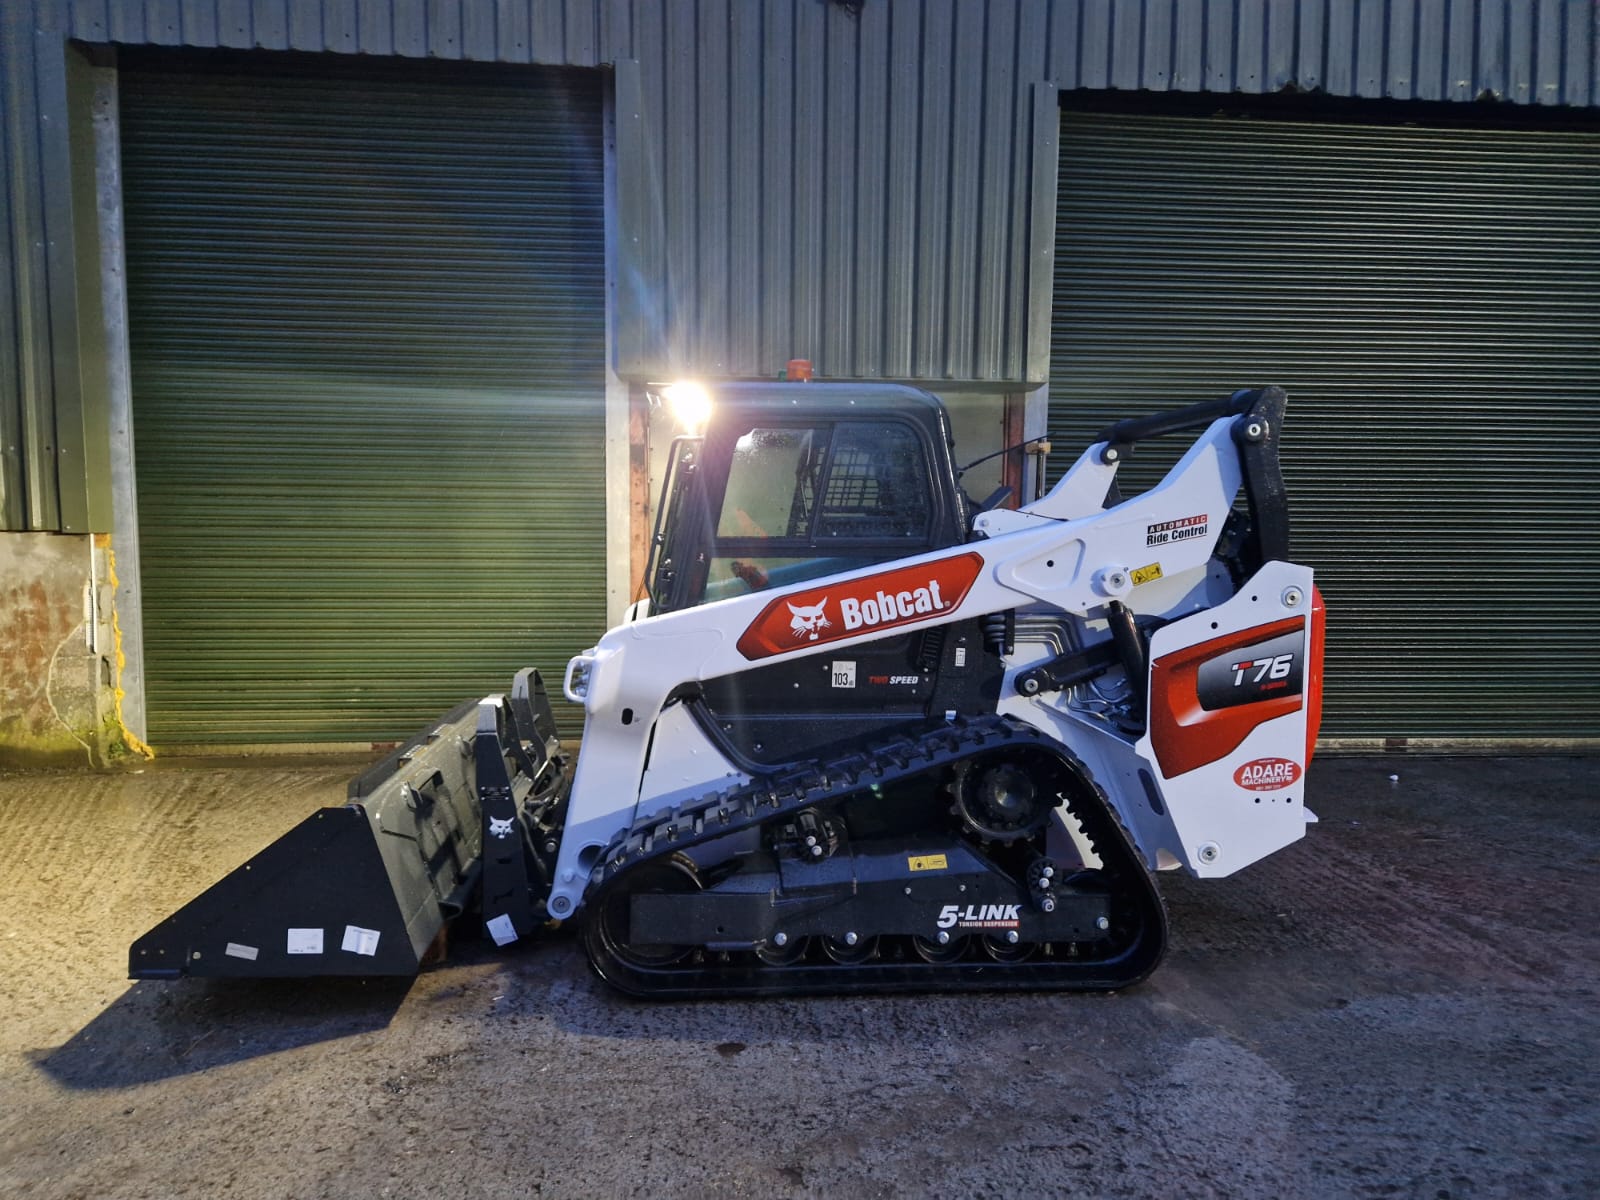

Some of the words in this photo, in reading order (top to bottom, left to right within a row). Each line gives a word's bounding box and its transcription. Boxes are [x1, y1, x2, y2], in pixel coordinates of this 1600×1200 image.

[1149, 515, 1207, 533] AUTOMATIC
[1147, 532, 1169, 545] Ride
[1171, 524, 1208, 540] Control
[840, 580, 943, 630] Bobcat
[1232, 653, 1294, 687] T76
[834, 673, 848, 686] 103
[868, 675, 889, 685] TWO
[889, 675, 919, 685] SPEED
[1241, 763, 1294, 780] ADARE
[1241, 775, 1287, 786] MACHINERY
[936, 904, 1023, 929] 5-LINK
